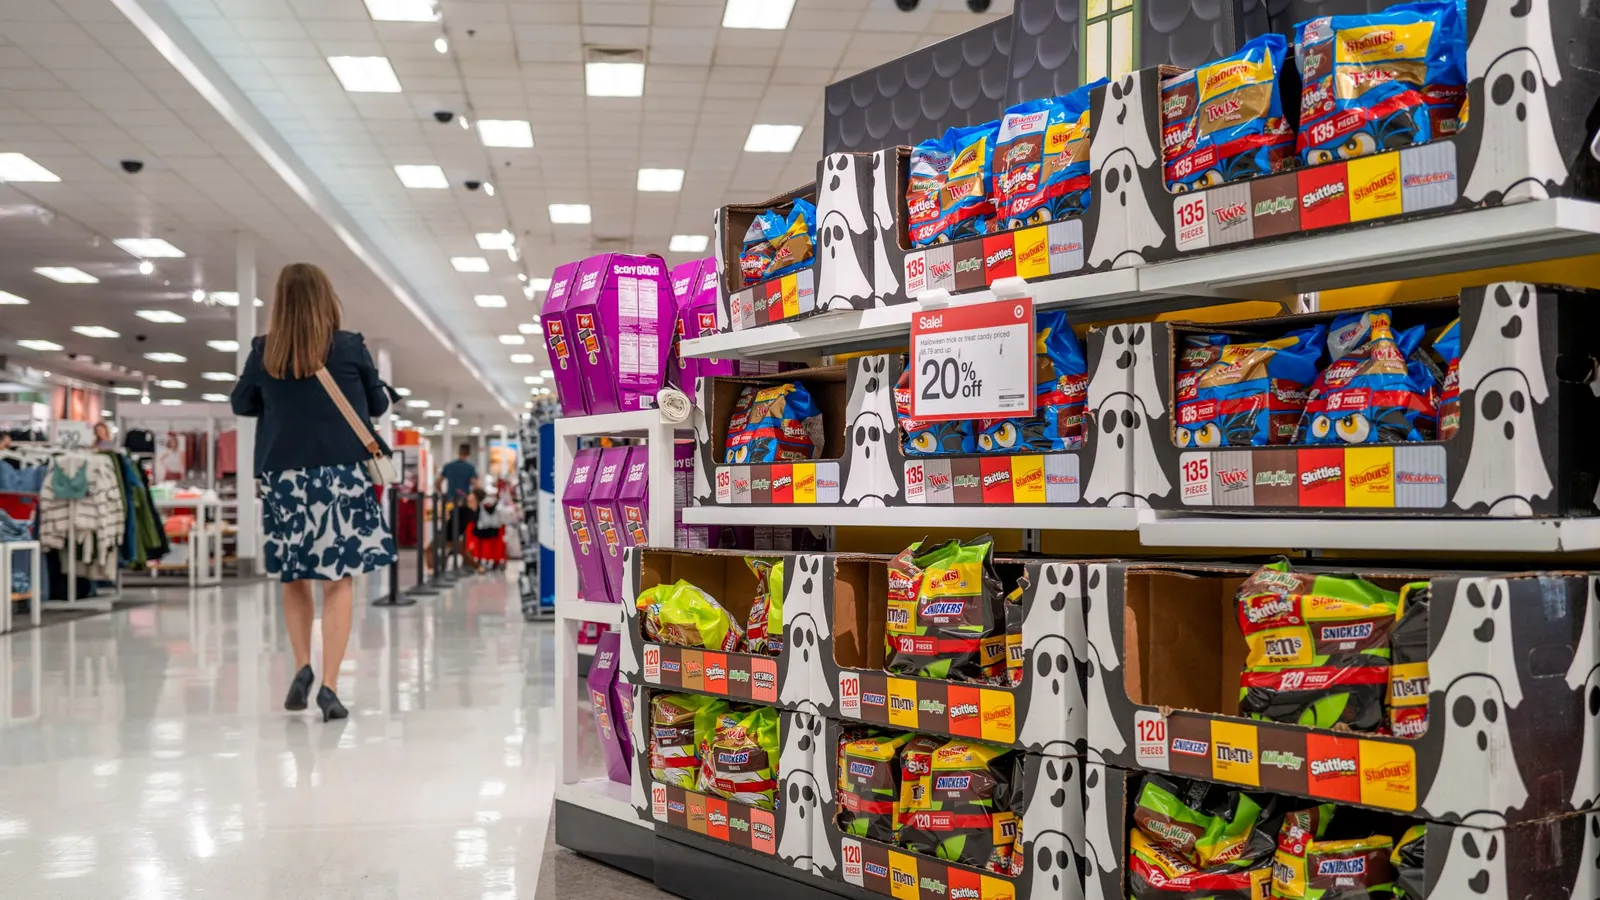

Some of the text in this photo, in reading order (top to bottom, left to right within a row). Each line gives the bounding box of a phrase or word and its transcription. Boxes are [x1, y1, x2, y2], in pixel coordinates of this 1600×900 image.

[1205, 98, 1240, 123] Twix
[1311, 113, 1359, 144] 135 PIECES
[1164, 128, 1193, 147] ittles
[1174, 152, 1213, 178] 135 PIECES
[947, 181, 974, 200] Twix
[1003, 171, 1034, 193] Skittles
[1353, 168, 1397, 202] Starburst
[1302, 181, 1345, 208] Skittles
[1012, 197, 1029, 213] 135
[1176, 199, 1205, 227] 135
[1212, 202, 1247, 224] Twix
[917, 225, 934, 238] 135
[1179, 226, 1204, 241] PIECES
[986, 246, 1014, 267] Skittles
[1018, 240, 1047, 264] Starburst
[613, 264, 636, 276] Scary
[906, 257, 925, 279] 135
[928, 262, 952, 277] Twix
[908, 279, 925, 291] PIECES
[919, 314, 943, 330] Sale!
[920, 337, 946, 346] Halloween
[976, 333, 992, 341] candy
[993, 330, 1011, 339] priced
[962, 380, 982, 398] off
[1326, 393, 1365, 410] 135 PIECES
[1181, 405, 1214, 422] 135 PIECES
[905, 465, 924, 485] 135
[1015, 467, 1042, 489] Starburst
[1182, 458, 1209, 482] 135
[1216, 469, 1248, 487] Twix
[1301, 465, 1341, 486] Skittles
[1349, 463, 1390, 489] Starburst
[716, 471, 730, 488] 135
[772, 475, 792, 489] Skittles
[927, 472, 950, 487] Twix
[983, 470, 1010, 488] Skittles
[907, 487, 923, 495] PIECES
[1185, 484, 1208, 495] PIECES
[923, 601, 964, 616] SNICKERS
[1249, 601, 1294, 623] Skittles
[933, 616, 950, 624] MINIS
[1322, 623, 1373, 640] SNICKERS
[899, 638, 914, 652] 120
[1339, 641, 1357, 650] MINIS
[644, 649, 659, 666] 120
[705, 667, 726, 678] Skittles
[1280, 672, 1329, 688] 120 PIECES
[839, 677, 858, 696] 120
[842, 699, 857, 707] PIECES
[862, 693, 885, 705] SNICKERS
[950, 703, 979, 718] Skittles
[983, 705, 1012, 722] Starburst
[1137, 719, 1165, 742] 120
[1140, 745, 1163, 756] PIECES
[1172, 738, 1208, 755] SNICKERS
[718, 751, 749, 764] SNICKERS
[850, 761, 875, 776] SNICKERS
[1311, 757, 1357, 776] Skittles
[1364, 761, 1412, 783] Starburst
[936, 776, 970, 789] SNICKERS
[653, 788, 666, 804] 120
[947, 790, 961, 798] MINIS
[914, 815, 930, 828] 120
[1148, 819, 1190, 843] Milky Way
[843, 845, 861, 863] 120
[845, 867, 860, 875] PIECES
[864, 862, 888, 877] SNICKERS
[1319, 857, 1366, 874] SNICKERS
[1335, 877, 1355, 886] MINIS
[951, 888, 979, 900] Skittles
